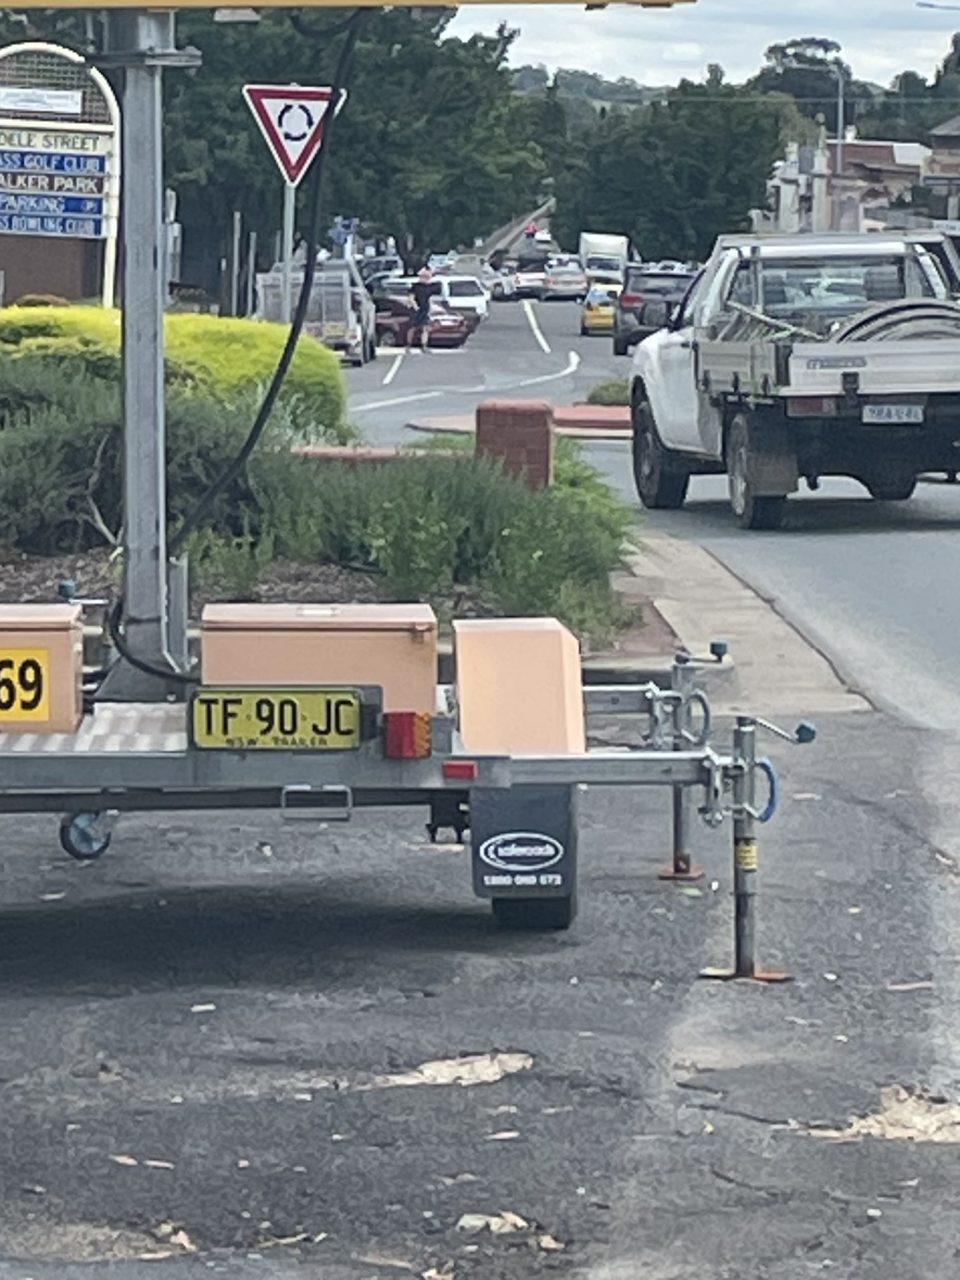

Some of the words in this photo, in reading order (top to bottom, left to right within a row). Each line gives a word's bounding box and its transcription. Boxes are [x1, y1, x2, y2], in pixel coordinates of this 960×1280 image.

[42, 133, 100, 151] STREET
[23, 153, 62, 169] GOLF
[63, 156, 100, 171] CLUB
[54, 177, 97, 193] PARK
[198, 697, 243, 735] TF
[255, 698, 298, 735] 90
[312, 698, 355, 736] JC
